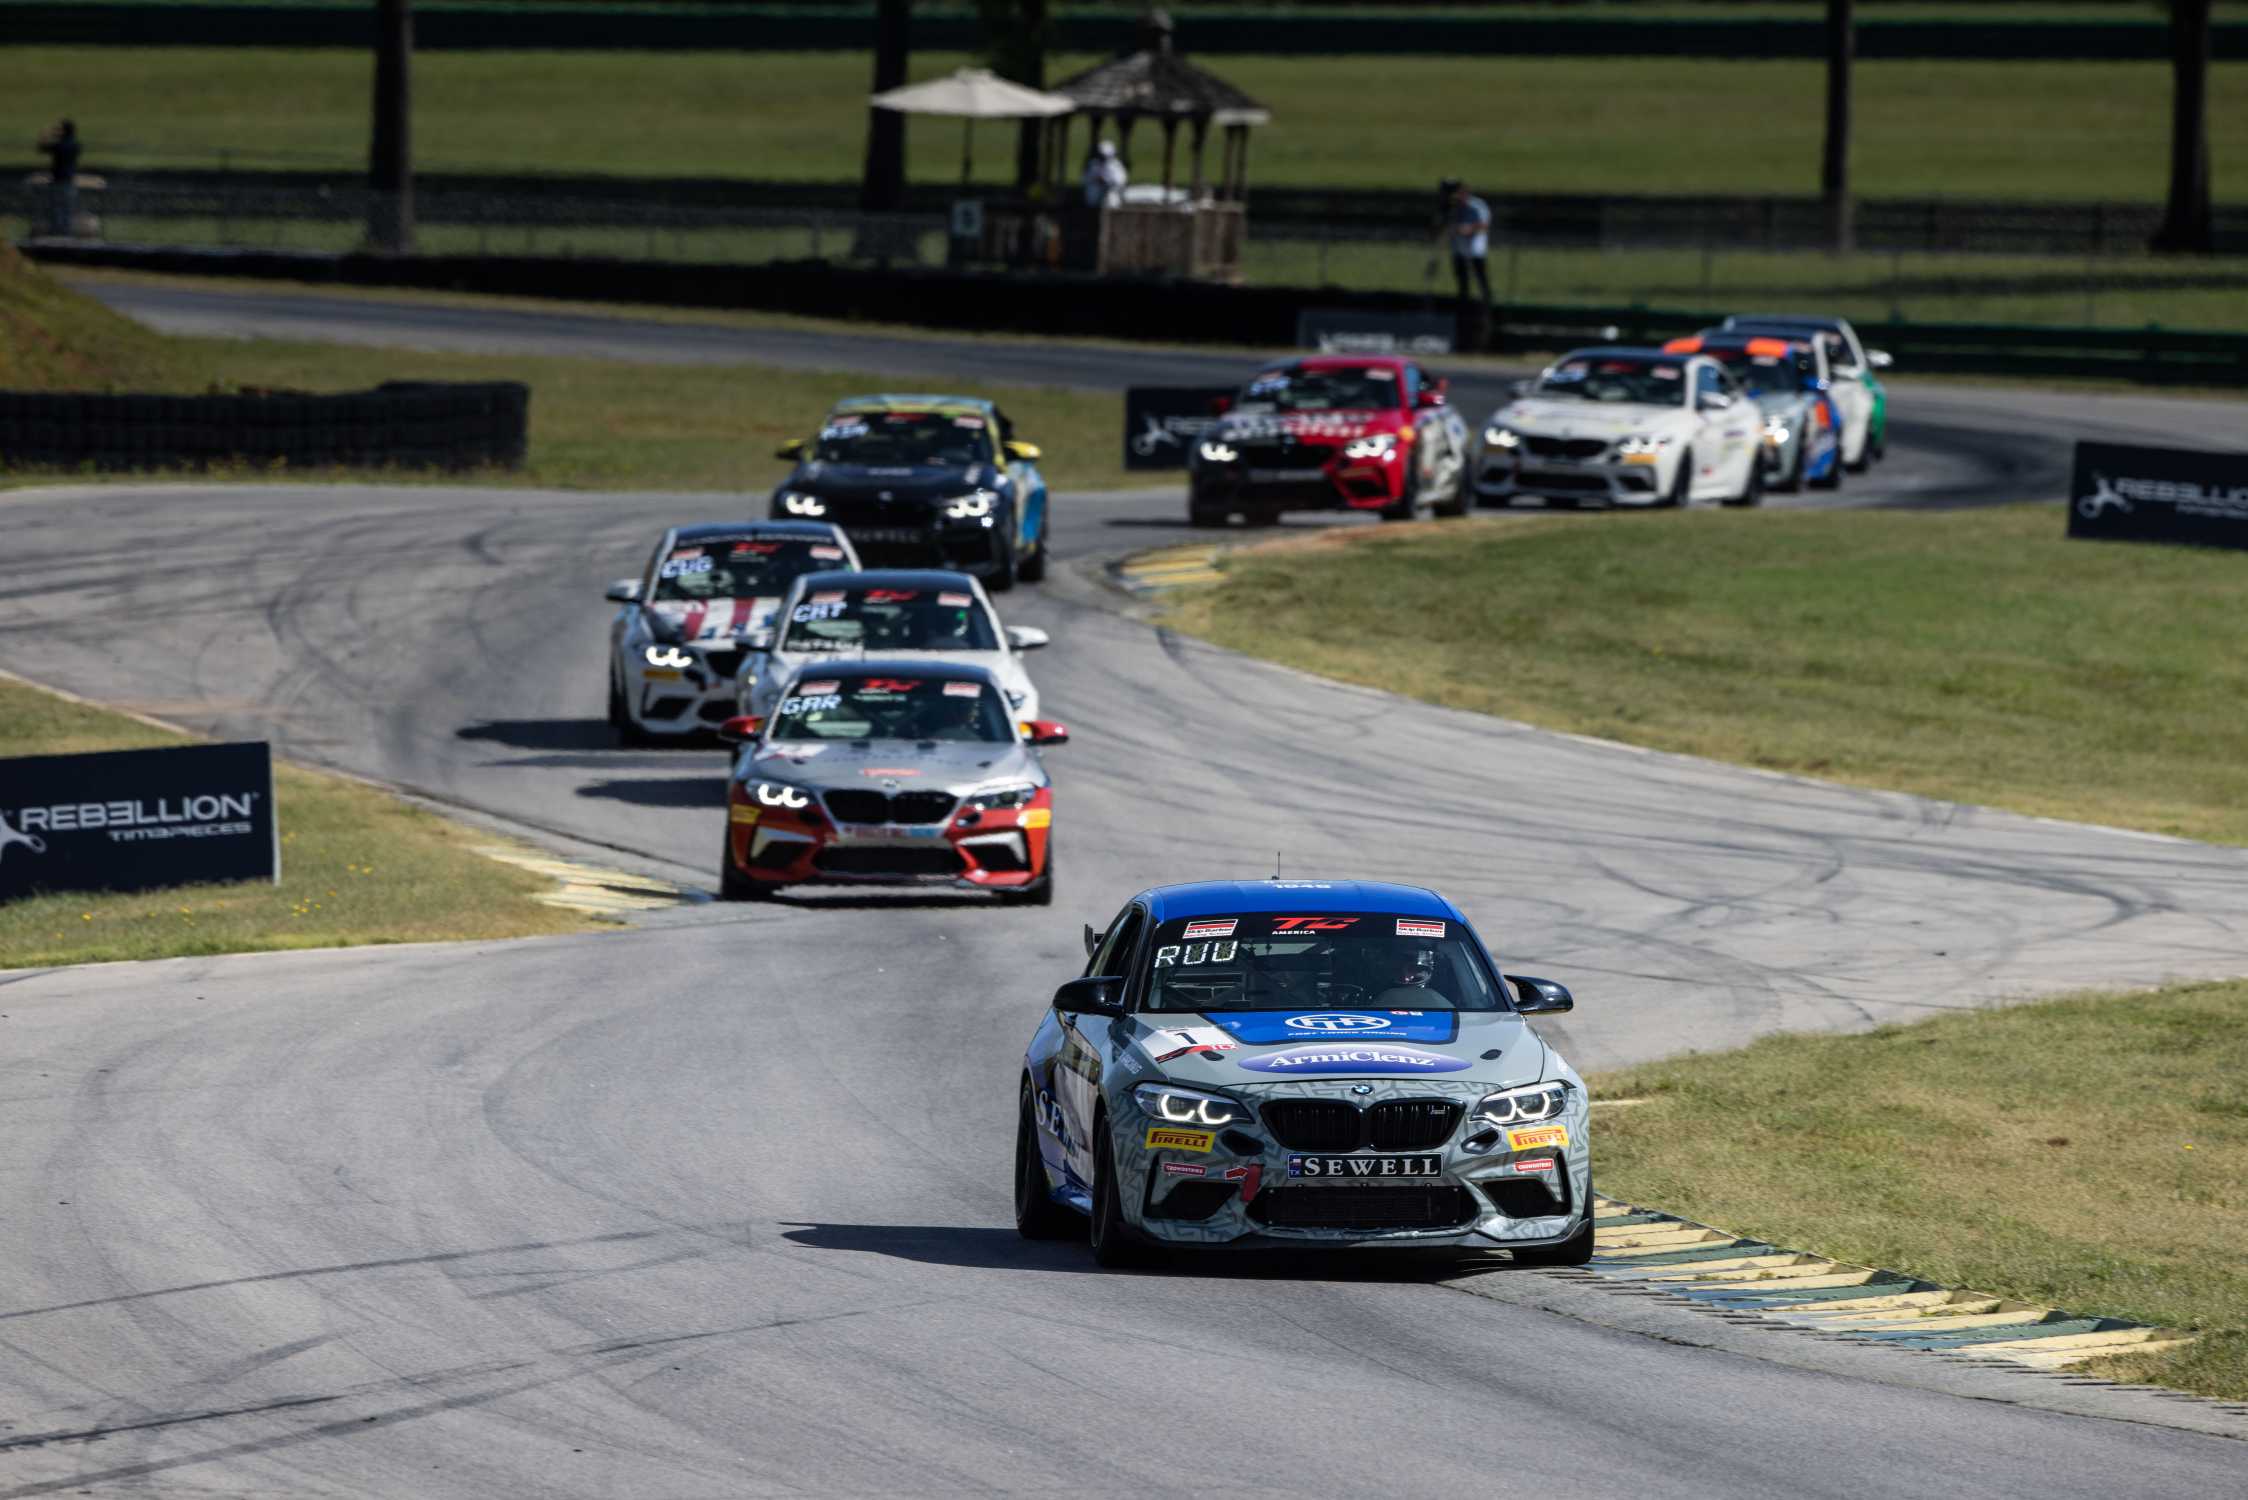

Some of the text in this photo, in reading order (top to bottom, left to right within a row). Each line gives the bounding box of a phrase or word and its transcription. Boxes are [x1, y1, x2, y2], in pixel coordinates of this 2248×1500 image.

[20, 793, 251, 832] REBELLION
[1174, 1032, 1199, 1045] 1
[1267, 1051, 1436, 1067] ArmiClenz
[1150, 1131, 1209, 1148] PIRELLI
[1303, 1157, 1439, 1177] SEWELL
